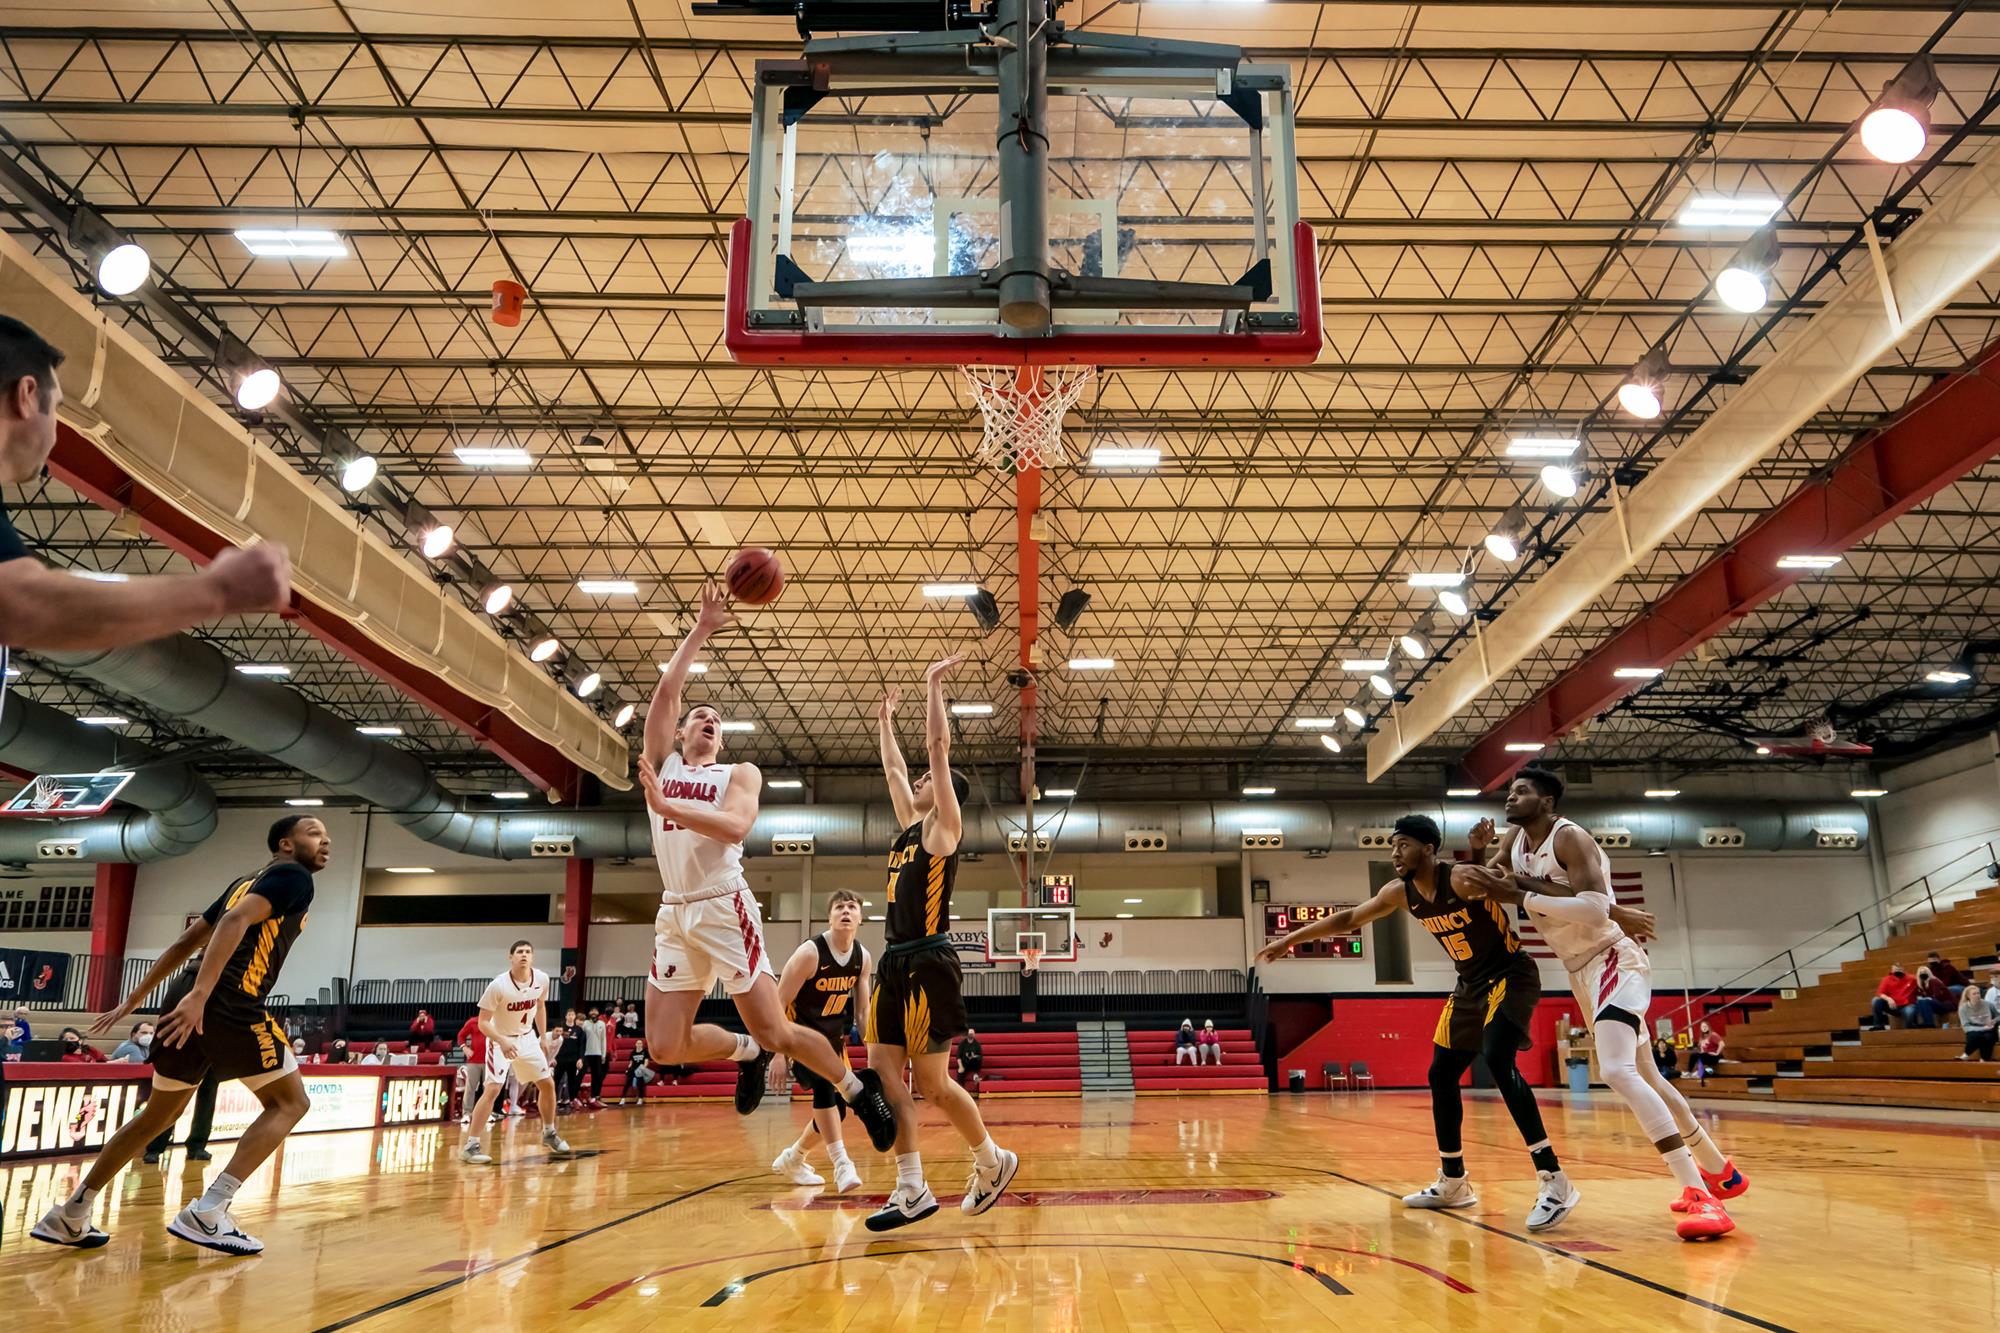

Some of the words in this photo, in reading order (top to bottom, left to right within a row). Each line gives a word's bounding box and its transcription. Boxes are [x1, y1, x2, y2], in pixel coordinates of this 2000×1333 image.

[662, 778, 717, 803] ARDINALS
[1046, 876, 1073, 886] 18:21
[1053, 887, 1068, 903] 10
[949, 931, 988, 943] AXBY'S
[1441, 932, 1473, 961] 15
[821, 994, 848, 1016] 10
[521, 1012, 528, 1025] 4
[308, 1084, 343, 1095] HONDA
[383, 1079, 442, 1123] JEWELL
[2, 1085, 139, 1153] JEWELL
